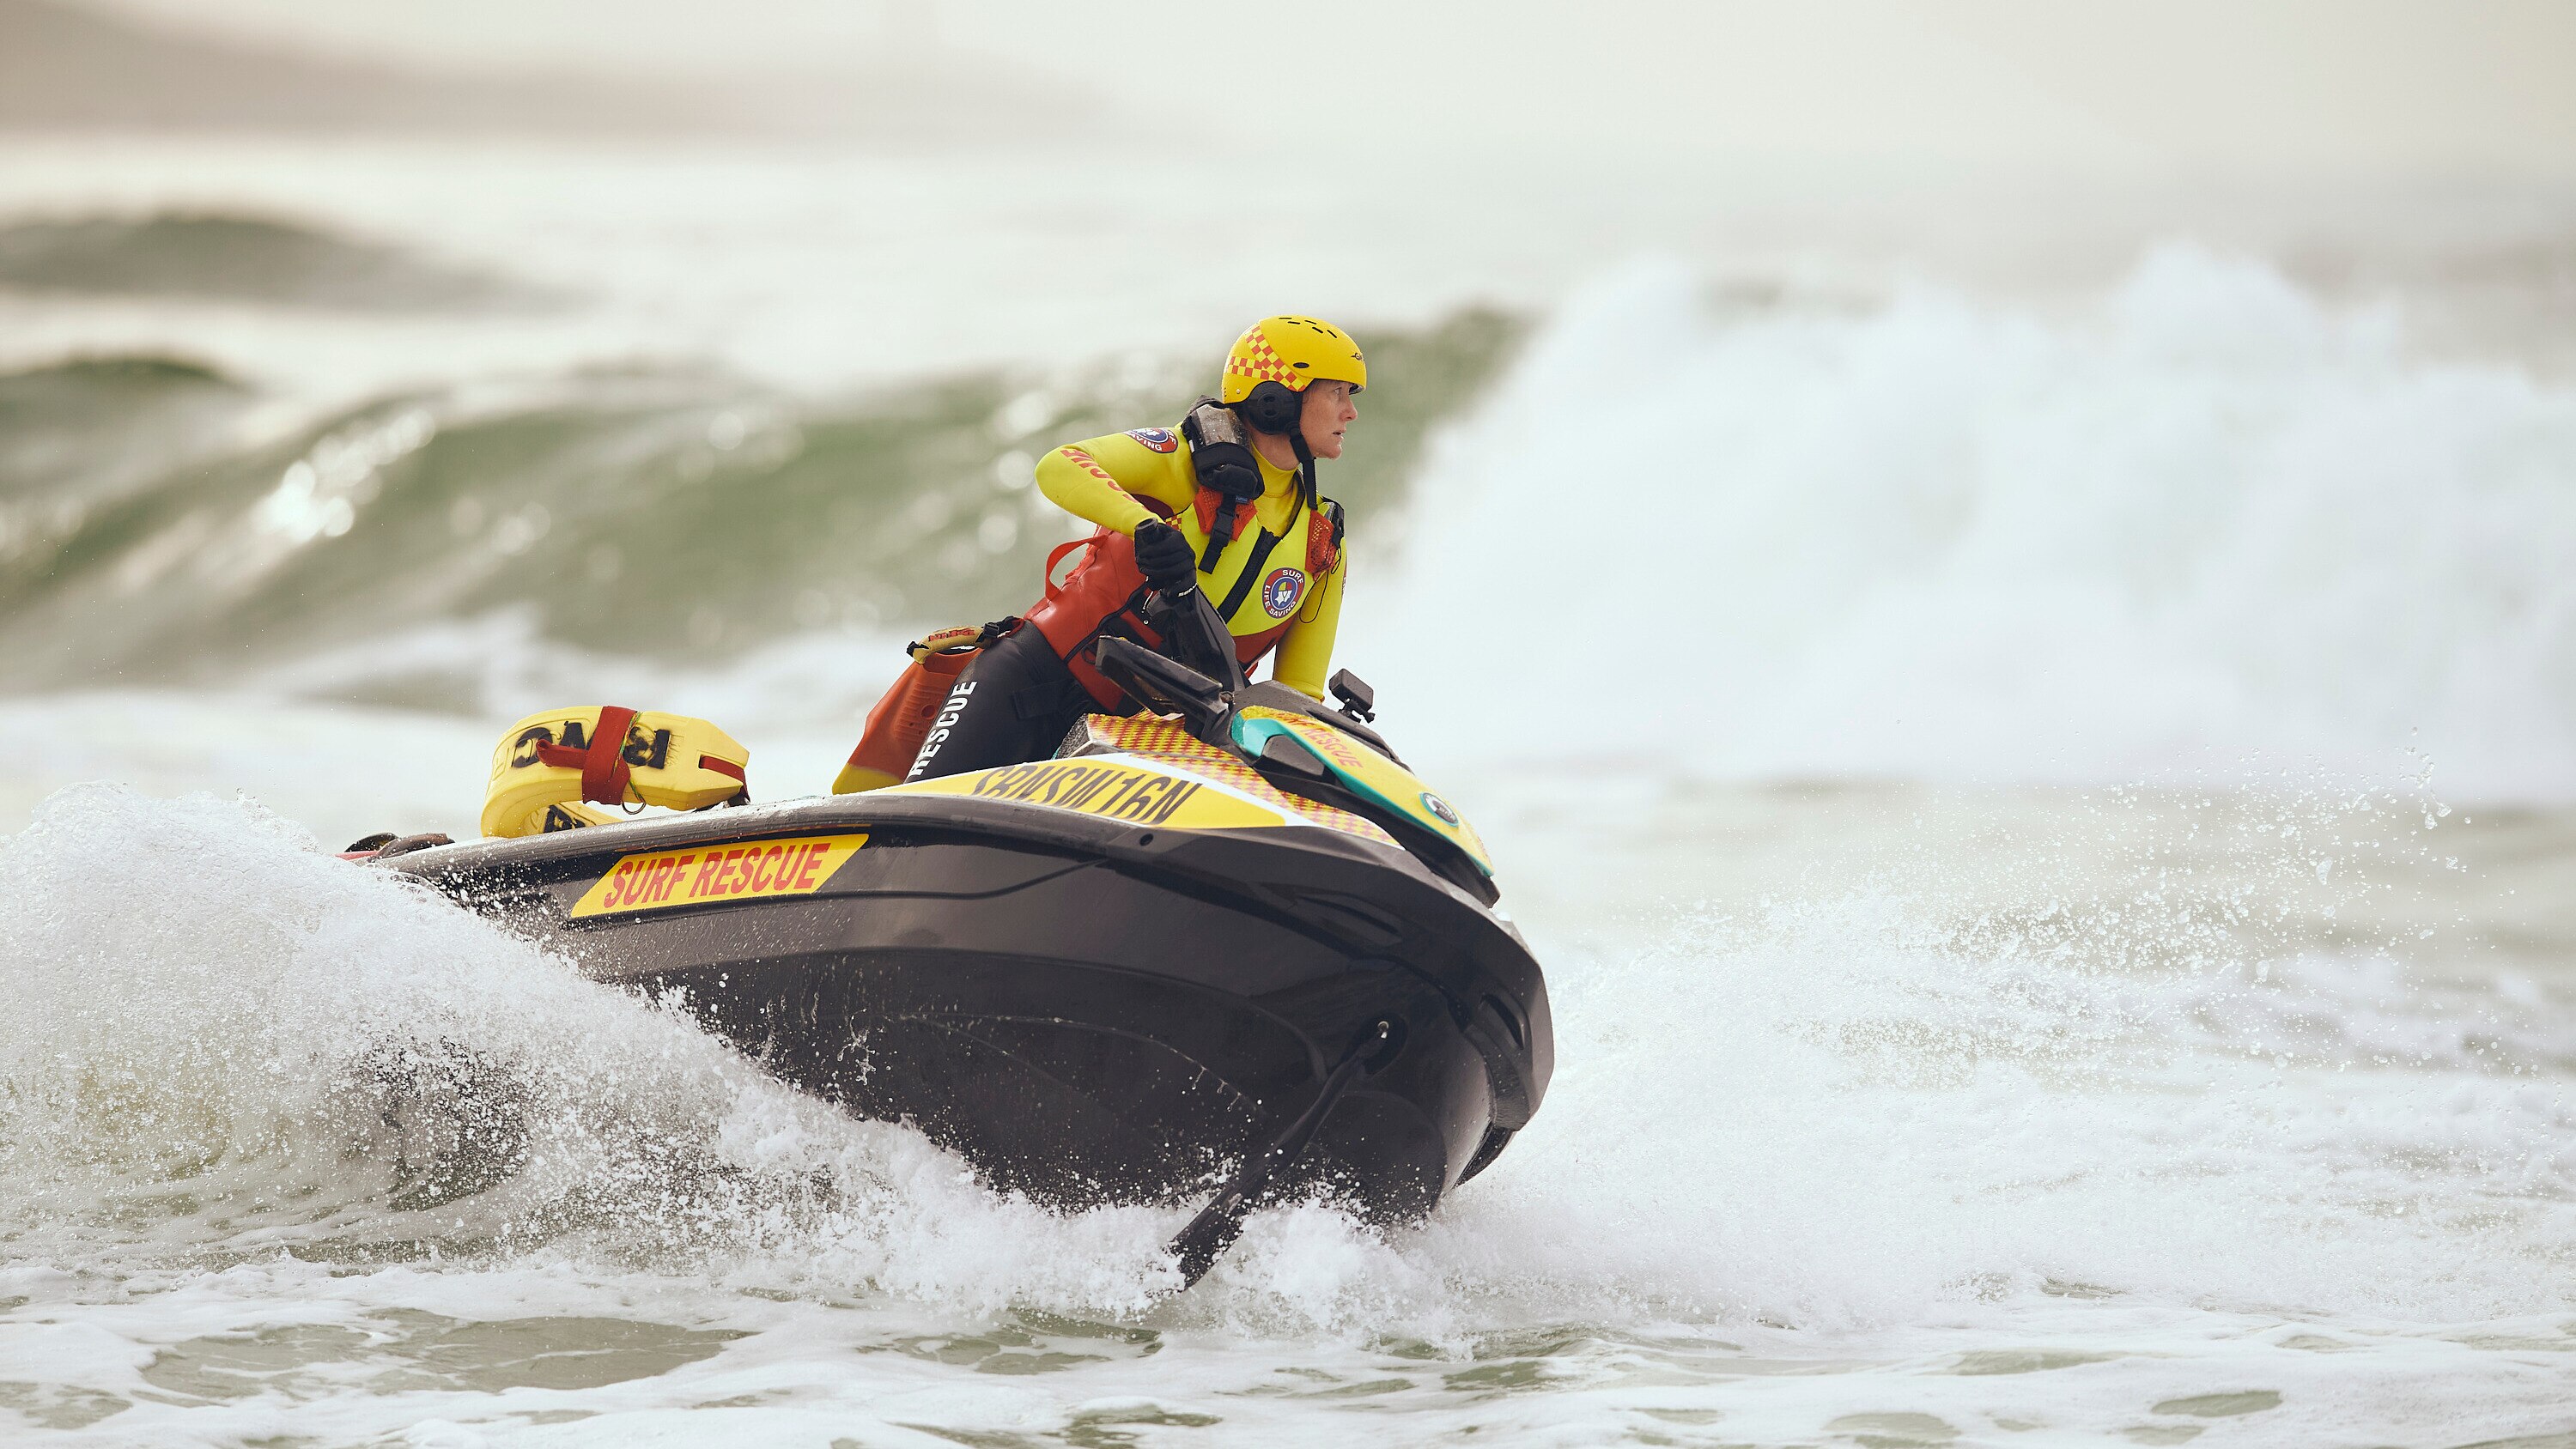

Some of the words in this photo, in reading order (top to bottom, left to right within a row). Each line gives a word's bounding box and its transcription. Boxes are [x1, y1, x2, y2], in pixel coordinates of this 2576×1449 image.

[1282, 569, 1303, 584] SURF
[1269, 601, 1297, 616] SAVING
[907, 680, 978, 780] RESCUE
[1299, 727, 1364, 768] RESCUE
[971, 765, 1127, 810] SRNSW
[1091, 773, 1204, 825] 16N
[603, 854, 696, 909] SURF
[688, 842, 832, 899] RESCUE
